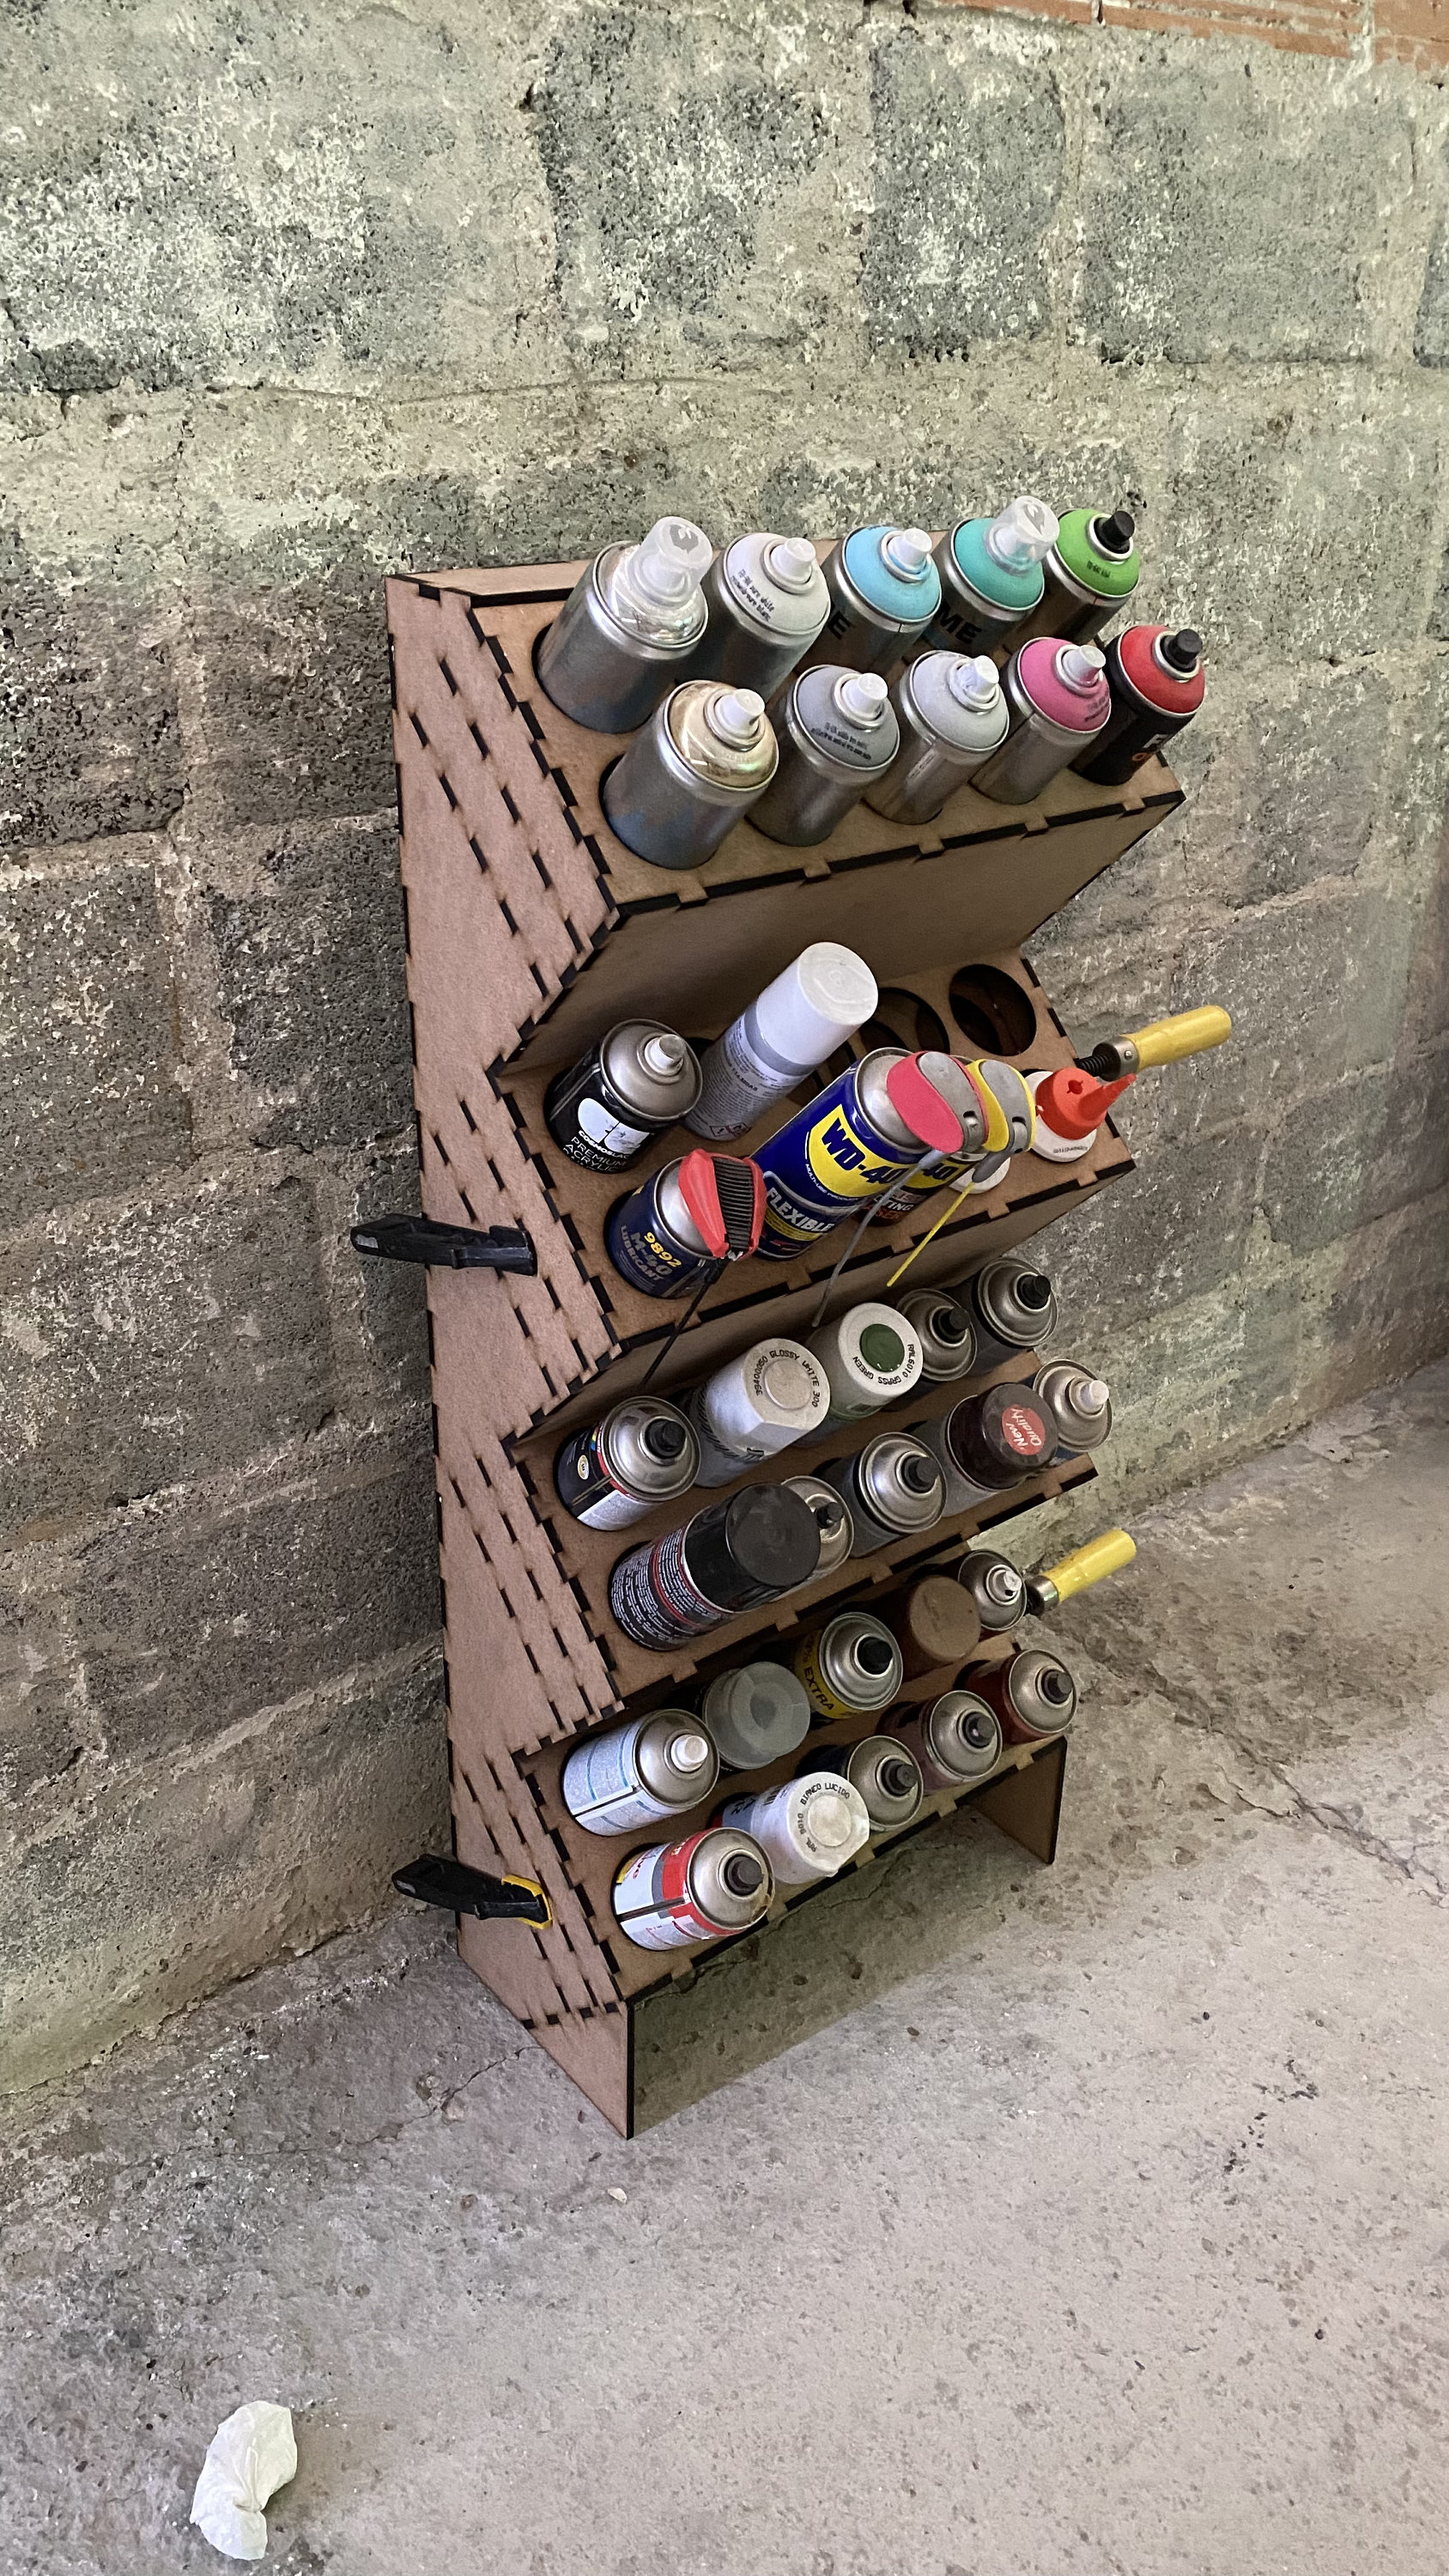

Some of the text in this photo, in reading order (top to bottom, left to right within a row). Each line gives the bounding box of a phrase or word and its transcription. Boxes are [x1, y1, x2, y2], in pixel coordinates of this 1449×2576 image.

[565, 1143, 620, 1171] ACRYLIC
[571, 1135, 627, 1166] PREMIUM
[578, 1129, 631, 1159] COSMOSLAC
[821, 1116, 910, 1184] WD-40
[766, 1187, 836, 1232] FLEXIBLE
[620, 1224, 664, 1282] LUBRICANT
[630, 1231, 673, 1276] M-40
[644, 1230, 682, 1268] 9892
[769, 1349, 801, 1361] GLOSSY
[852, 1356, 875, 1380] GREEN
[802, 1360, 821, 1388] WHITE
[877, 1375, 902, 1386] GRASS
[810, 1390, 821, 1408] 300
[803, 1666, 834, 1710] EXTRA
[799, 1783, 822, 1806] BIANCO
[824, 1782, 851, 1800] LUCIDO
